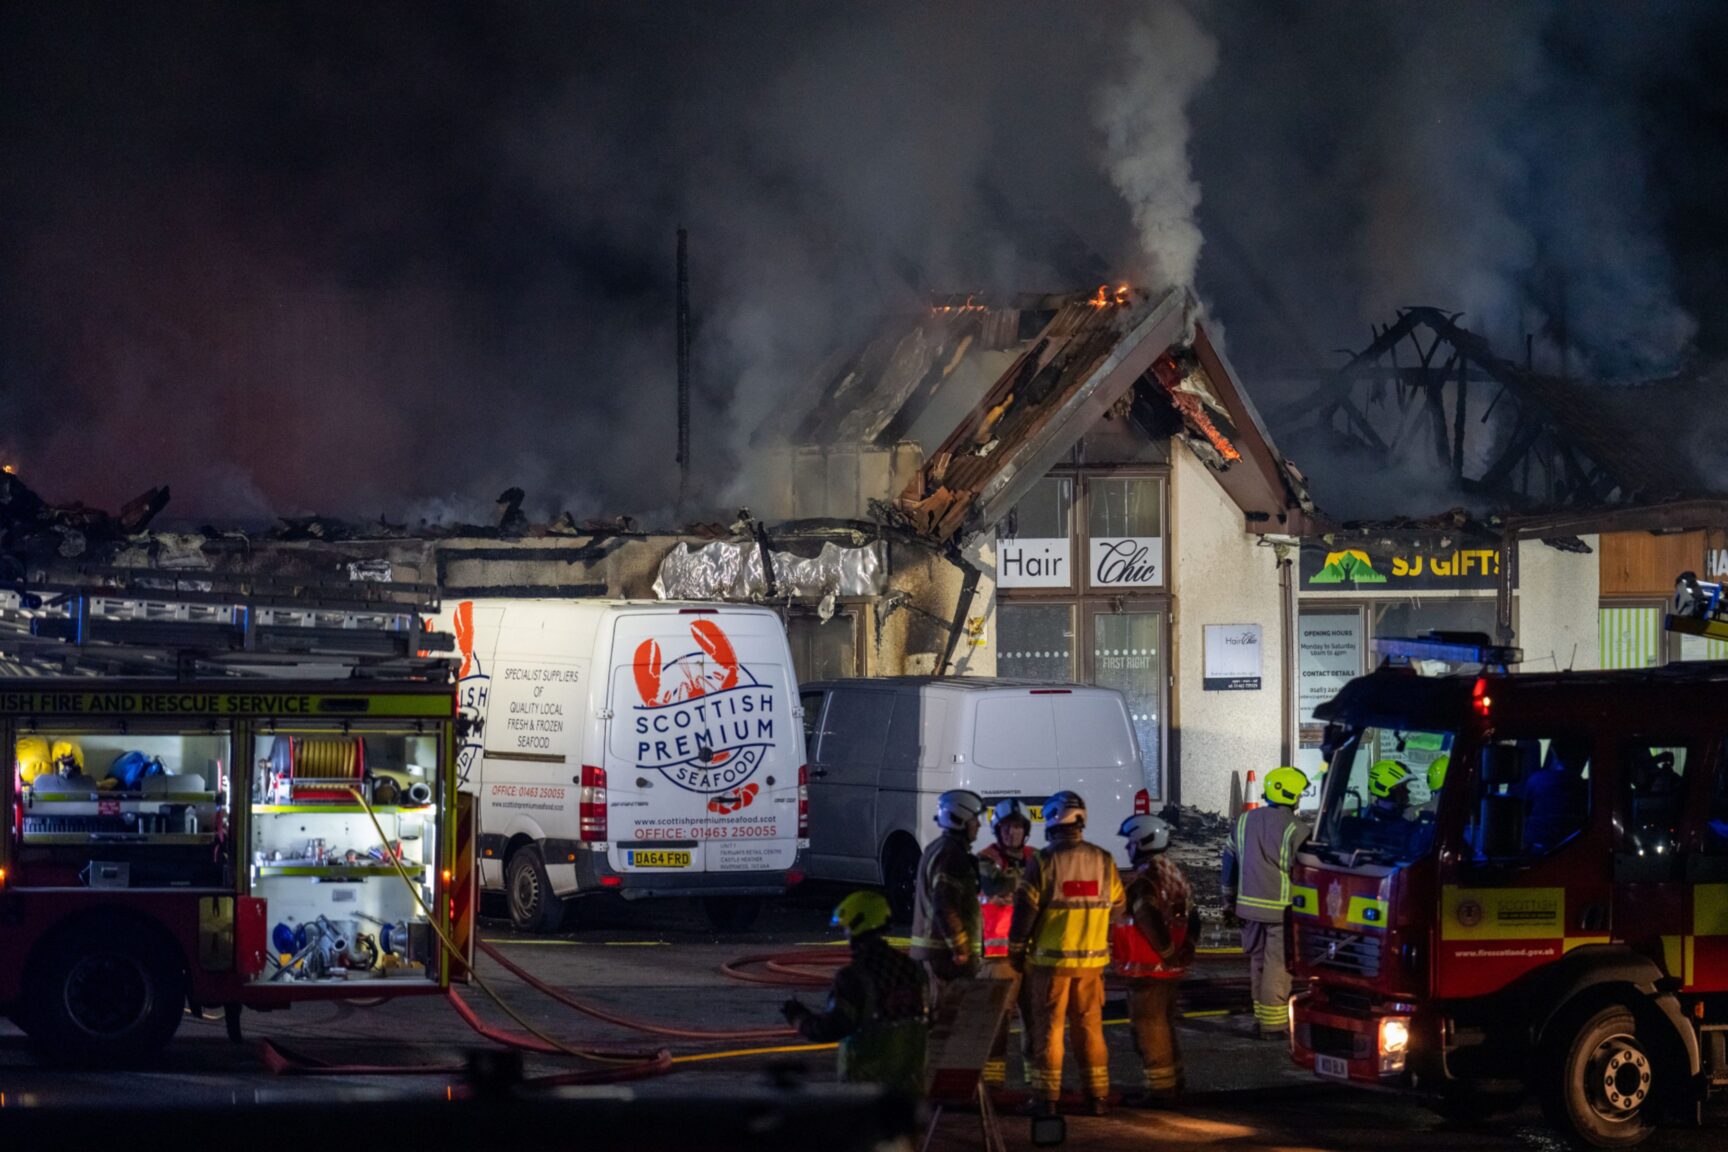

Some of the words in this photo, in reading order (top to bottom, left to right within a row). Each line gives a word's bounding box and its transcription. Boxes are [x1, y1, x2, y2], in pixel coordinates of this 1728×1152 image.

[1003, 548, 1063, 577] Hair
[1097, 539, 1155, 584] Chic
[1392, 555, 1423, 577] SJ
[1102, 656, 1125, 669] FIRST
[1127, 656, 1151, 669] RIGHT
[504, 668, 541, 681] SPECIALIST
[543, 670, 579, 682] SUPPLIERS
[533, 686, 545, 698] OF
[41, 695, 83, 711] FIRE
[89, 695, 136, 711] AND
[142, 695, 220, 712] RESCUE
[227, 695, 310, 712] SERVICE
[510, 701, 540, 714] QUALITY
[540, 703, 564, 716] LOCAL
[636, 694, 773, 734] SCOTTISH
[507, 718, 529, 731] FRESH
[529, 720, 535, 731] &
[536, 719, 564, 732] FROZEN
[517, 736, 550, 749] SEAFOOD
[638, 719, 773, 761] PREMIUM
[676, 750, 756, 787] SEAFOOD
[492, 784, 517, 796] OFFICE:
[518, 786, 539, 798] 01463
[539, 787, 566, 799] 250055
[634, 816, 777, 826] www.scottishpremiumseafood.scot
[634, 828, 687, 839] OFFICE:
[690, 827, 727, 839] 01463
[732, 826, 777, 838] 250055
[635, 852, 664, 864] DA64
[667, 852, 689, 865] FRD
